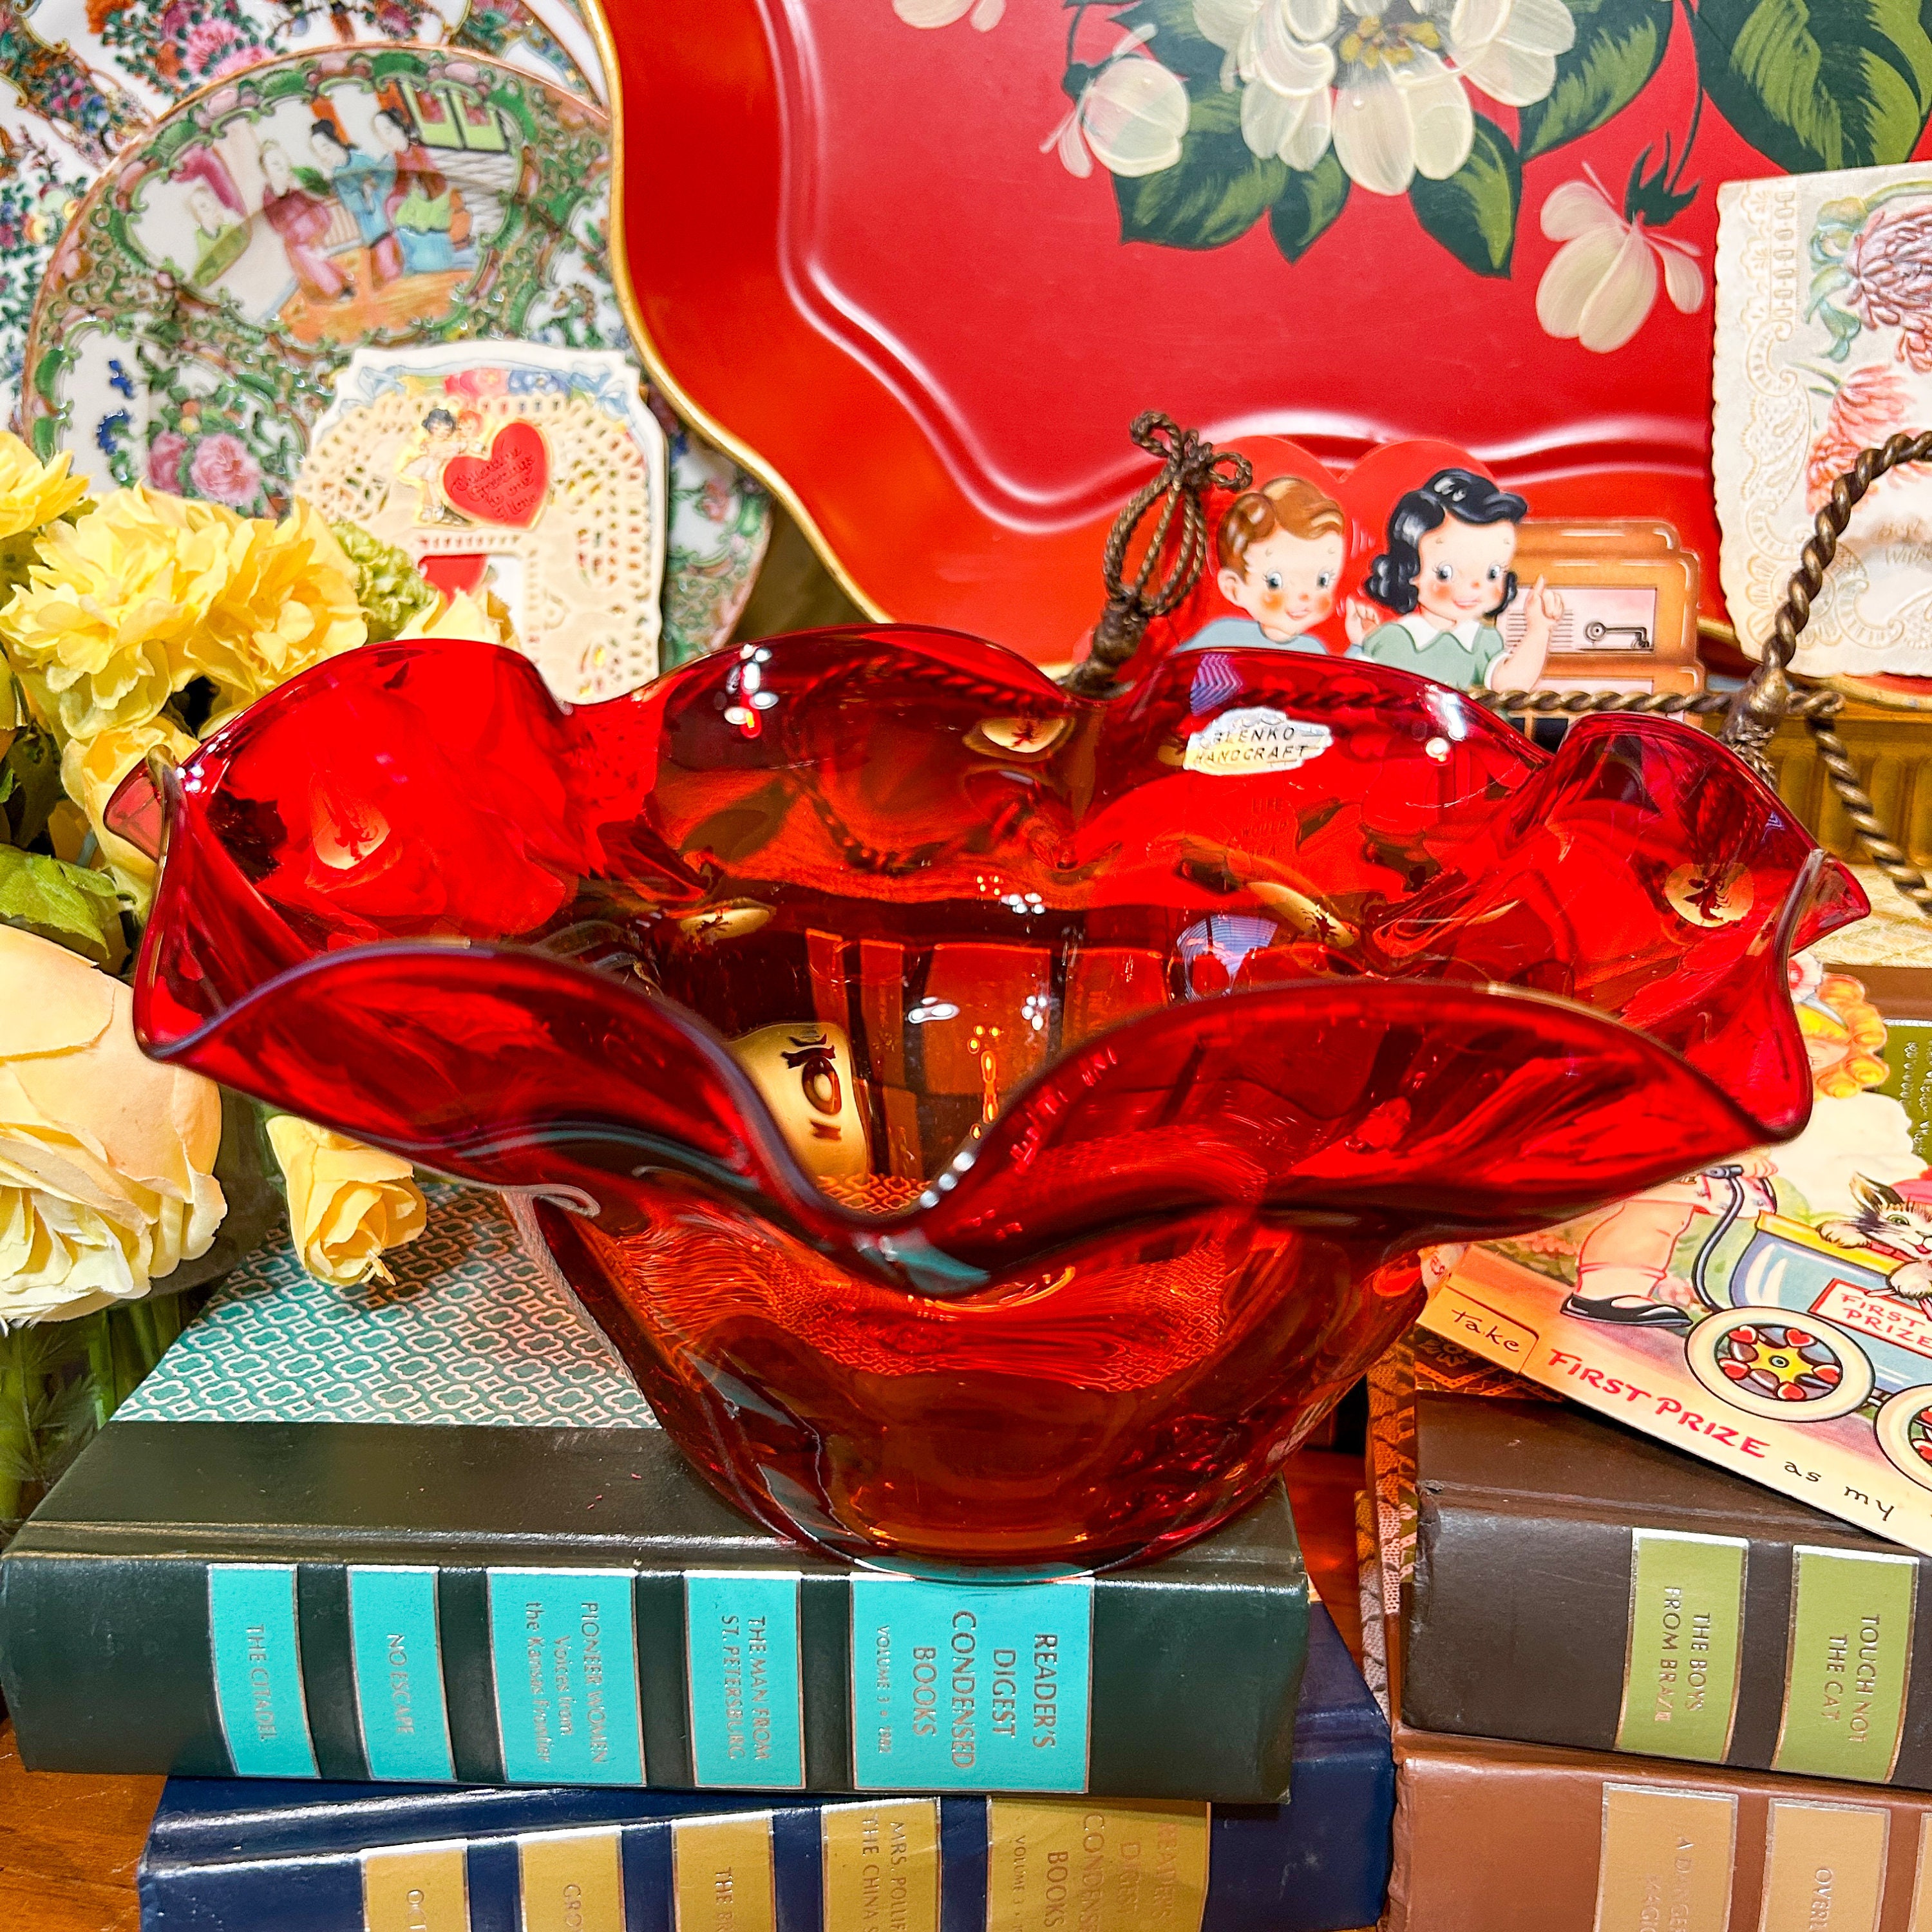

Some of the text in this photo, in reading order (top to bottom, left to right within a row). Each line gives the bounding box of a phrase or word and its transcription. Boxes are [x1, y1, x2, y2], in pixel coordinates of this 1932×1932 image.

[1841, 1293, 1926, 1327] FIRST
[1842, 1308, 1932, 1349] PRIZE
[1548, 1348, 1652, 1403] FIRST
[1655, 1396, 1771, 1458] PRIZE
[1783, 1461, 1822, 1482] as
[1843, 1486, 1895, 1522] my
[245, 1624, 267, 1662] THE
[526, 1602, 545, 1631] the
[1661, 1586, 1681, 1651] FROM
[386, 1633, 415, 1735] NO ESCAPE
[527, 1636, 545, 1695] Kansas
[554, 1635, 573, 1692] Voices
[581, 1602, 609, 1763] PIONEER WOMEN
[721, 1615, 745, 1760] ST. PETERSBURG
[748, 1615, 771, 1760] THE MAN FROM
[876, 1625, 891, 1690] VOLUME
[912, 1647, 938, 1736] BOOKS
[951, 1610, 976, 1768] CONDENSED
[1032, 1633, 1058, 1748] READER'S
[1685, 1612, 1710, 1712] THE BOYS
[1821, 1634, 1848, 1721] THE CAT
[1848, 1614, 1880, 1743] TOUCH NOT
[992, 1649, 1016, 1739] DIGEST
[862, 1813, 880, 1856] THE
[1013, 1835, 1027, 1893] VOLUME
[563, 1884, 582, 1932] GRO
[715, 1866, 734, 1906] THE
[862, 1864, 880, 1919] CHINA
[1043, 1850, 1068, 1927] BOOKS
